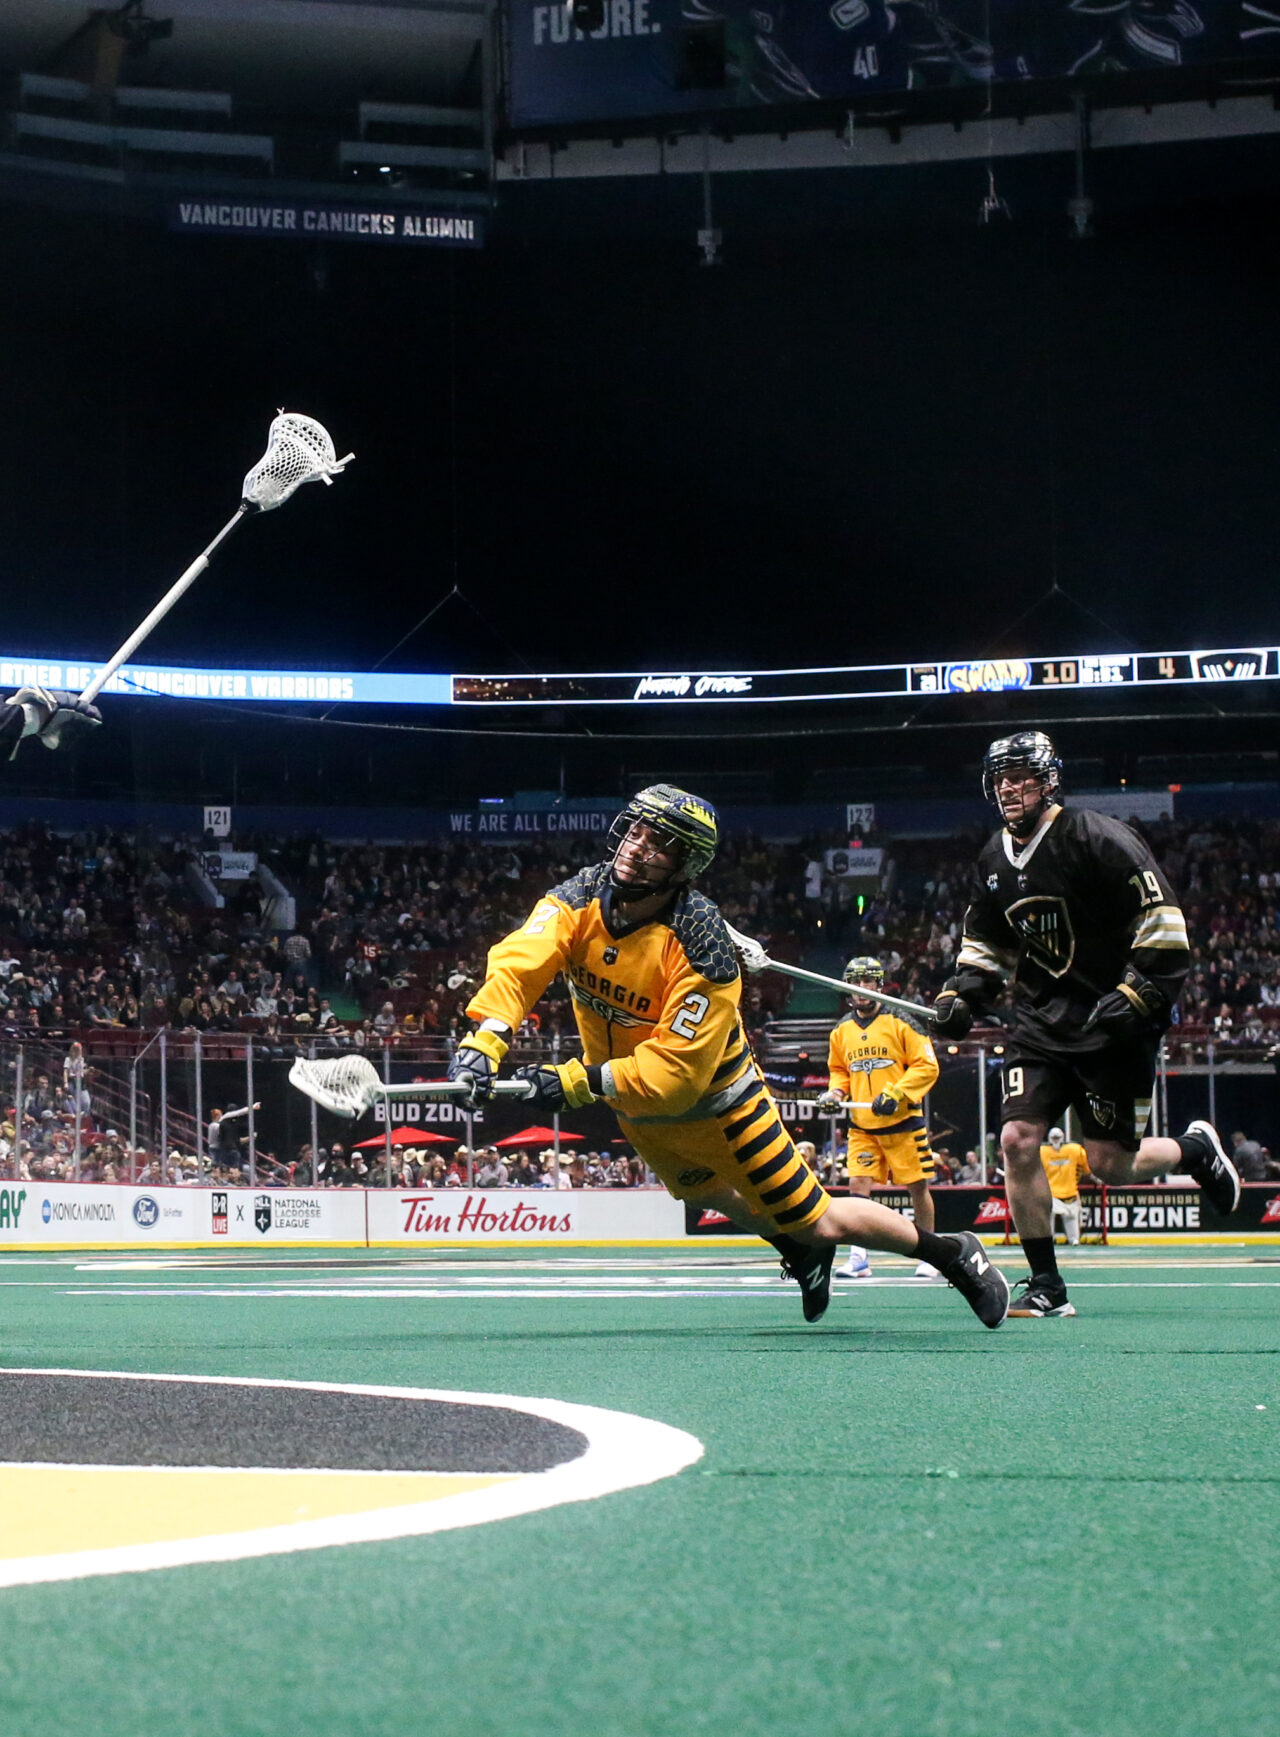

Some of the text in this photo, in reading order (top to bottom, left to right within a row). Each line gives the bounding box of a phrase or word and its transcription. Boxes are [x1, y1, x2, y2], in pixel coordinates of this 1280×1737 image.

[533, 0, 661, 45] FURE.
[179, 203, 475, 241] VANCOUVER CANUCKS ALUMNI
[1042, 662, 1076, 684] 10
[1158, 656, 1175, 678] 4
[66, 666, 90, 689] OF
[133, 670, 247, 698] VANCOUVER
[251, 676, 354, 699] WARRIORS
[207, 809, 228, 827] 121
[450, 814, 473, 833] WE
[478, 814, 510, 833] ARE
[514, 813, 540, 832] ALL
[1128, 870, 1164, 907] 19
[524, 903, 561, 935] 2
[570, 964, 651, 1013] GEORGIA
[670, 991, 711, 1041] 2
[848, 1046, 888, 1061] GEORGIA
[375, 1102, 485, 1123] BUD ZONE
[776, 1101, 814, 1121] UD
[274, 1199, 321, 1208] NATIONAL
[1136, 1194, 1201, 1205] WARRIORS
[53, 1203, 116, 1222] KONICA MINOLTA
[136, 1199, 157, 1223] Ford
[274, 1209, 322, 1219] LACROSSE
[401, 1195, 572, 1233] Tim Hortons
[1133, 1205, 1201, 1223] ZONE
[213, 1218, 228, 1233] LIVE
[274, 1219, 310, 1229] LEAGUE
